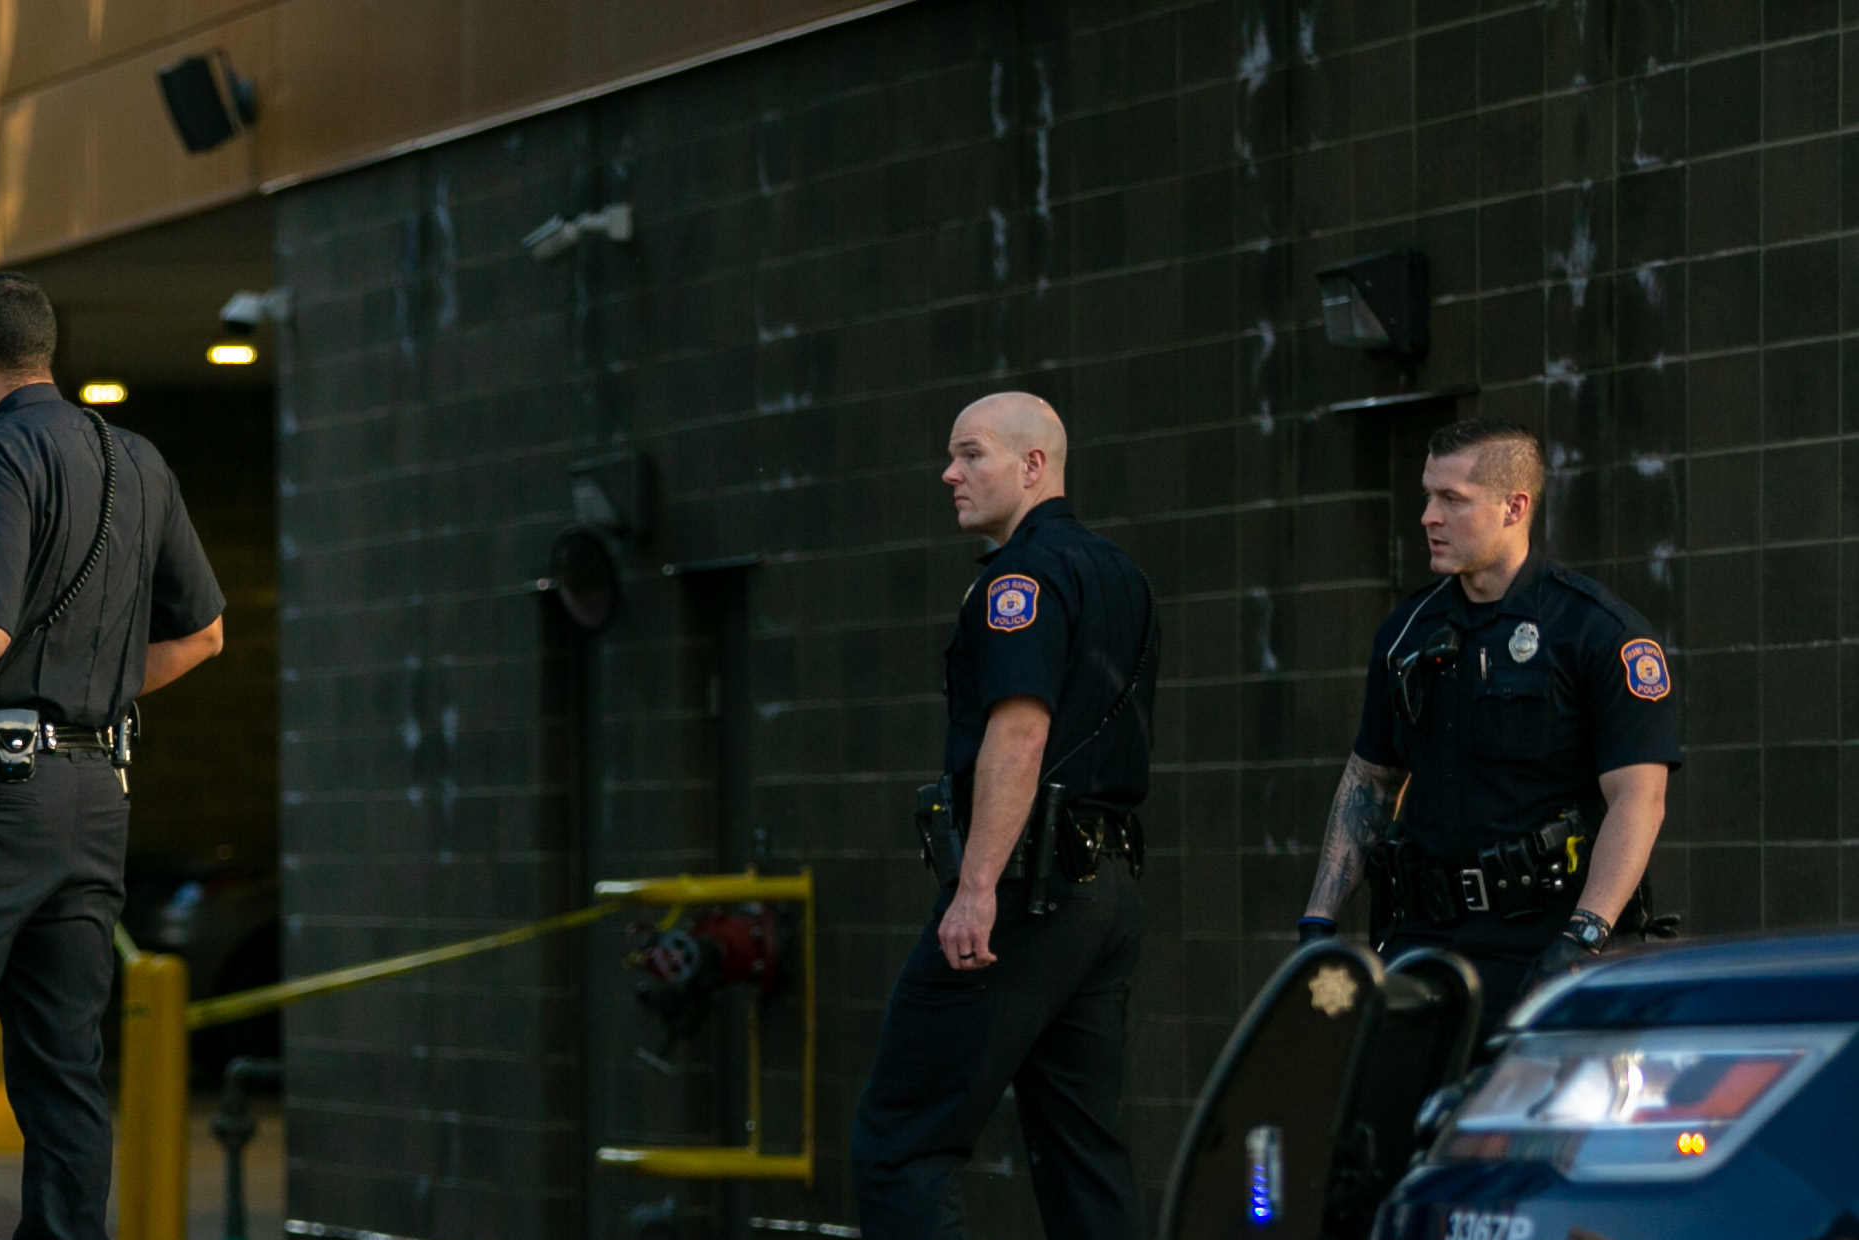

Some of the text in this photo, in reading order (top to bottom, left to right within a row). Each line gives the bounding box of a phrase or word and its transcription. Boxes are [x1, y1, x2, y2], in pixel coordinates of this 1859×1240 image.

[990, 580, 1035, 597] GRAND RAPIDS
[994, 615, 1027, 625] POLICE
[1636, 683, 1665, 695] POLICE
